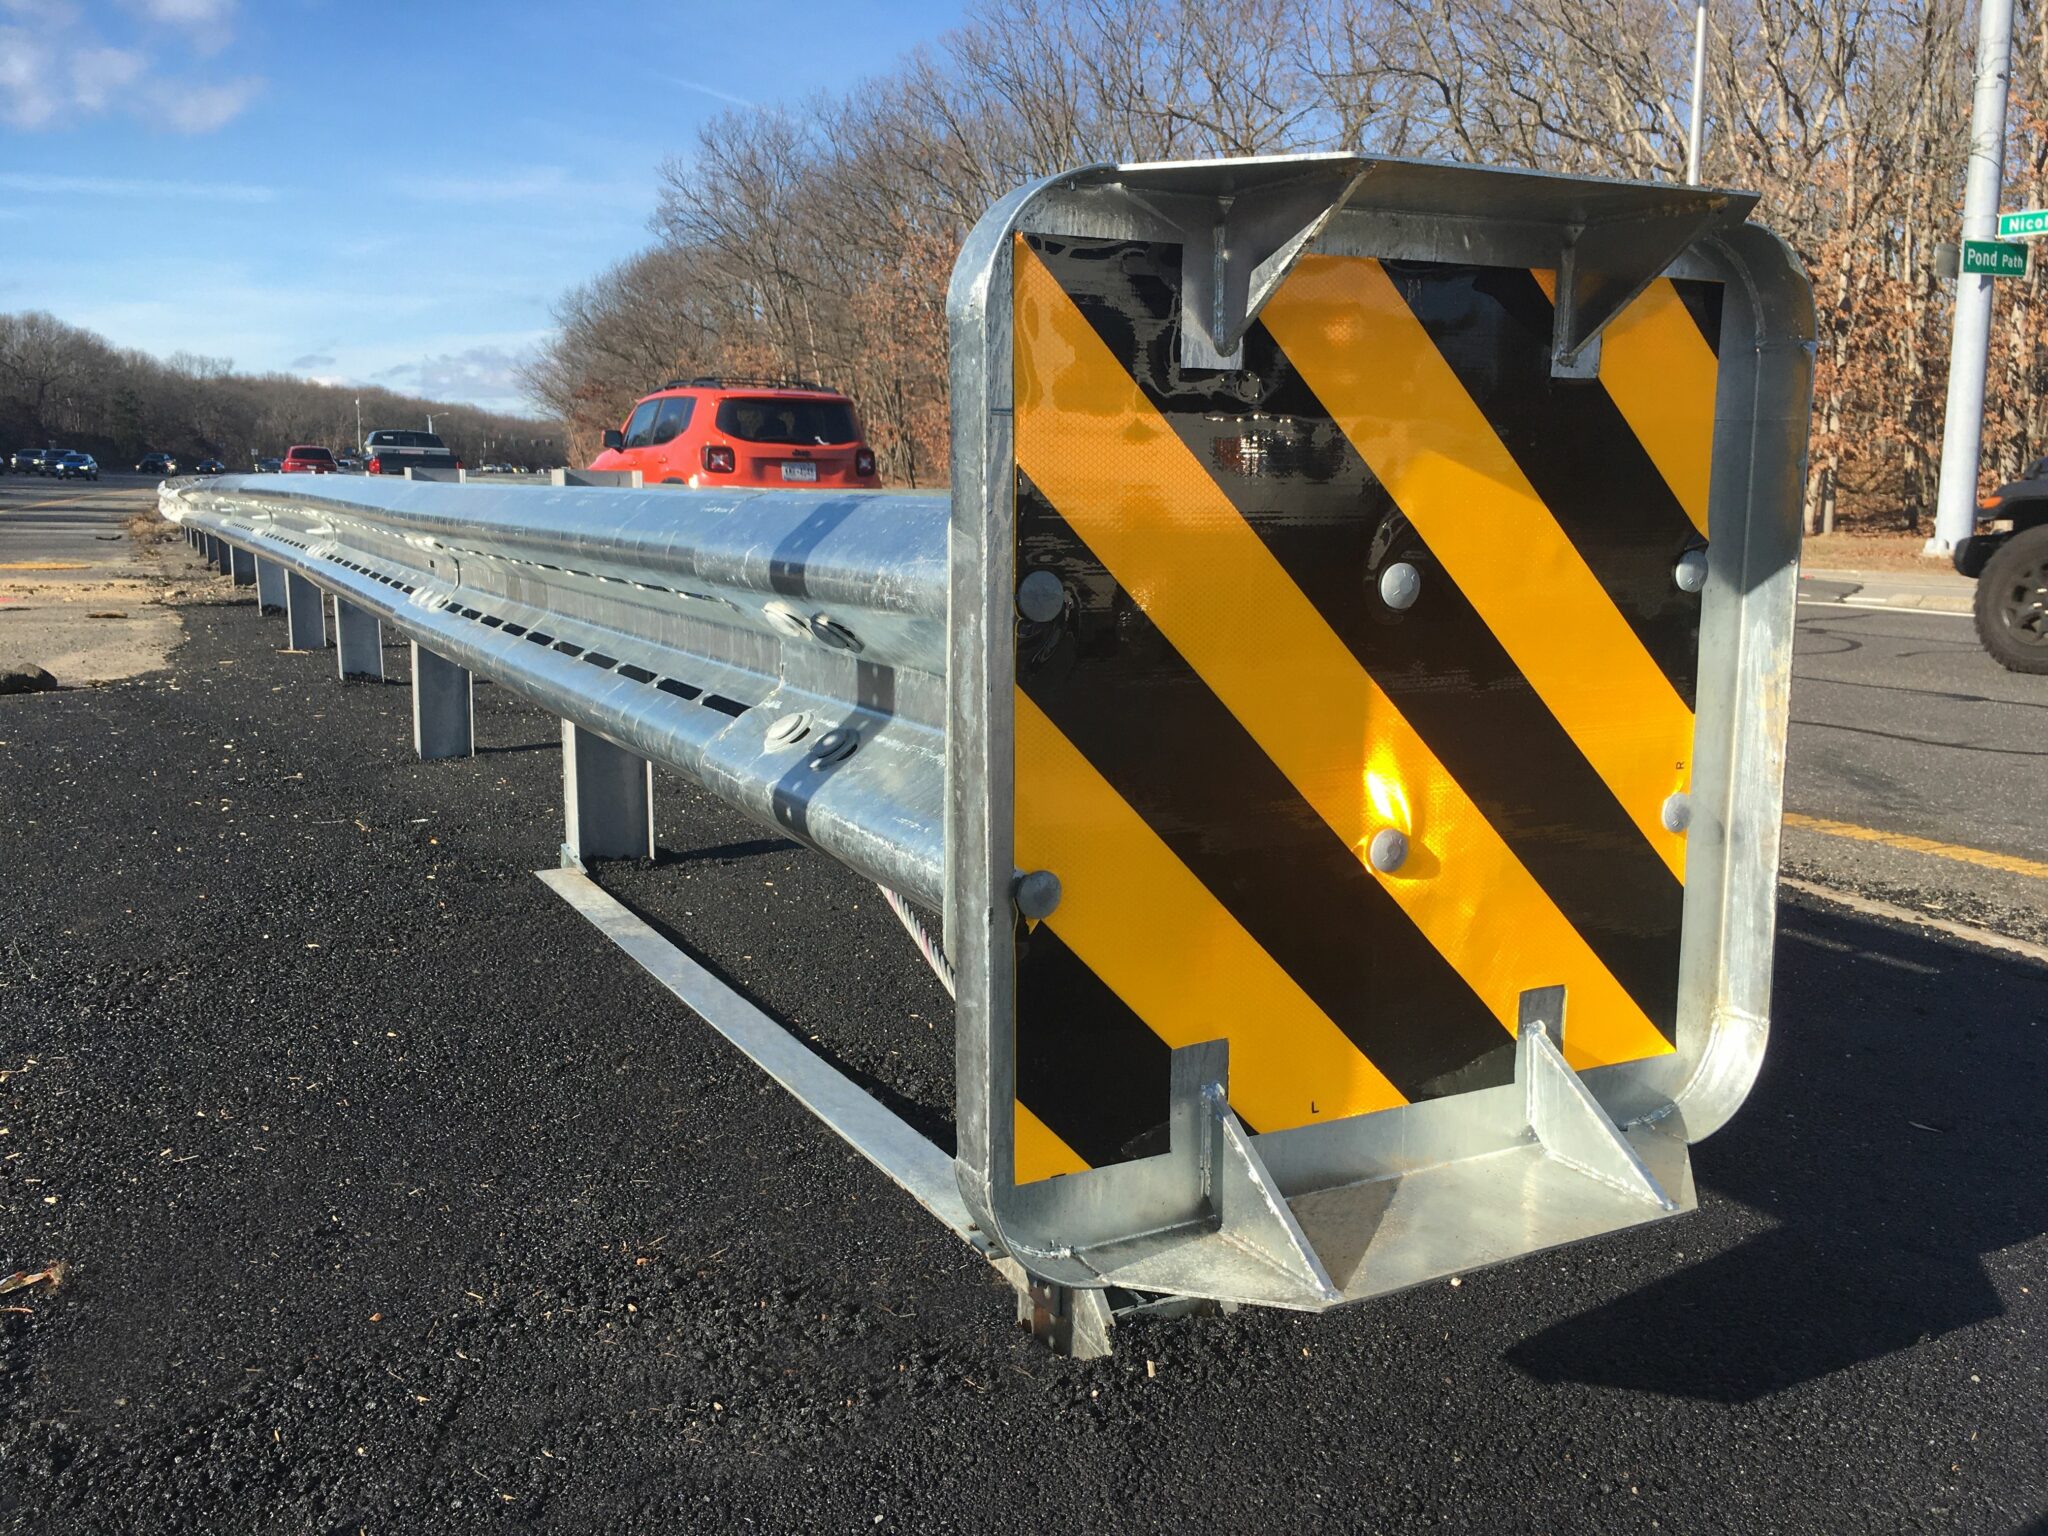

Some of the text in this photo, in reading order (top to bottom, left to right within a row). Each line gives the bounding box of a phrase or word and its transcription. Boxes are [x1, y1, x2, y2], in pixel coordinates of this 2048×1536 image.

[1967, 248, 2023, 268] Pond Path
[1675, 761, 1685, 770] R
[1311, 1100, 1320, 1114] L
